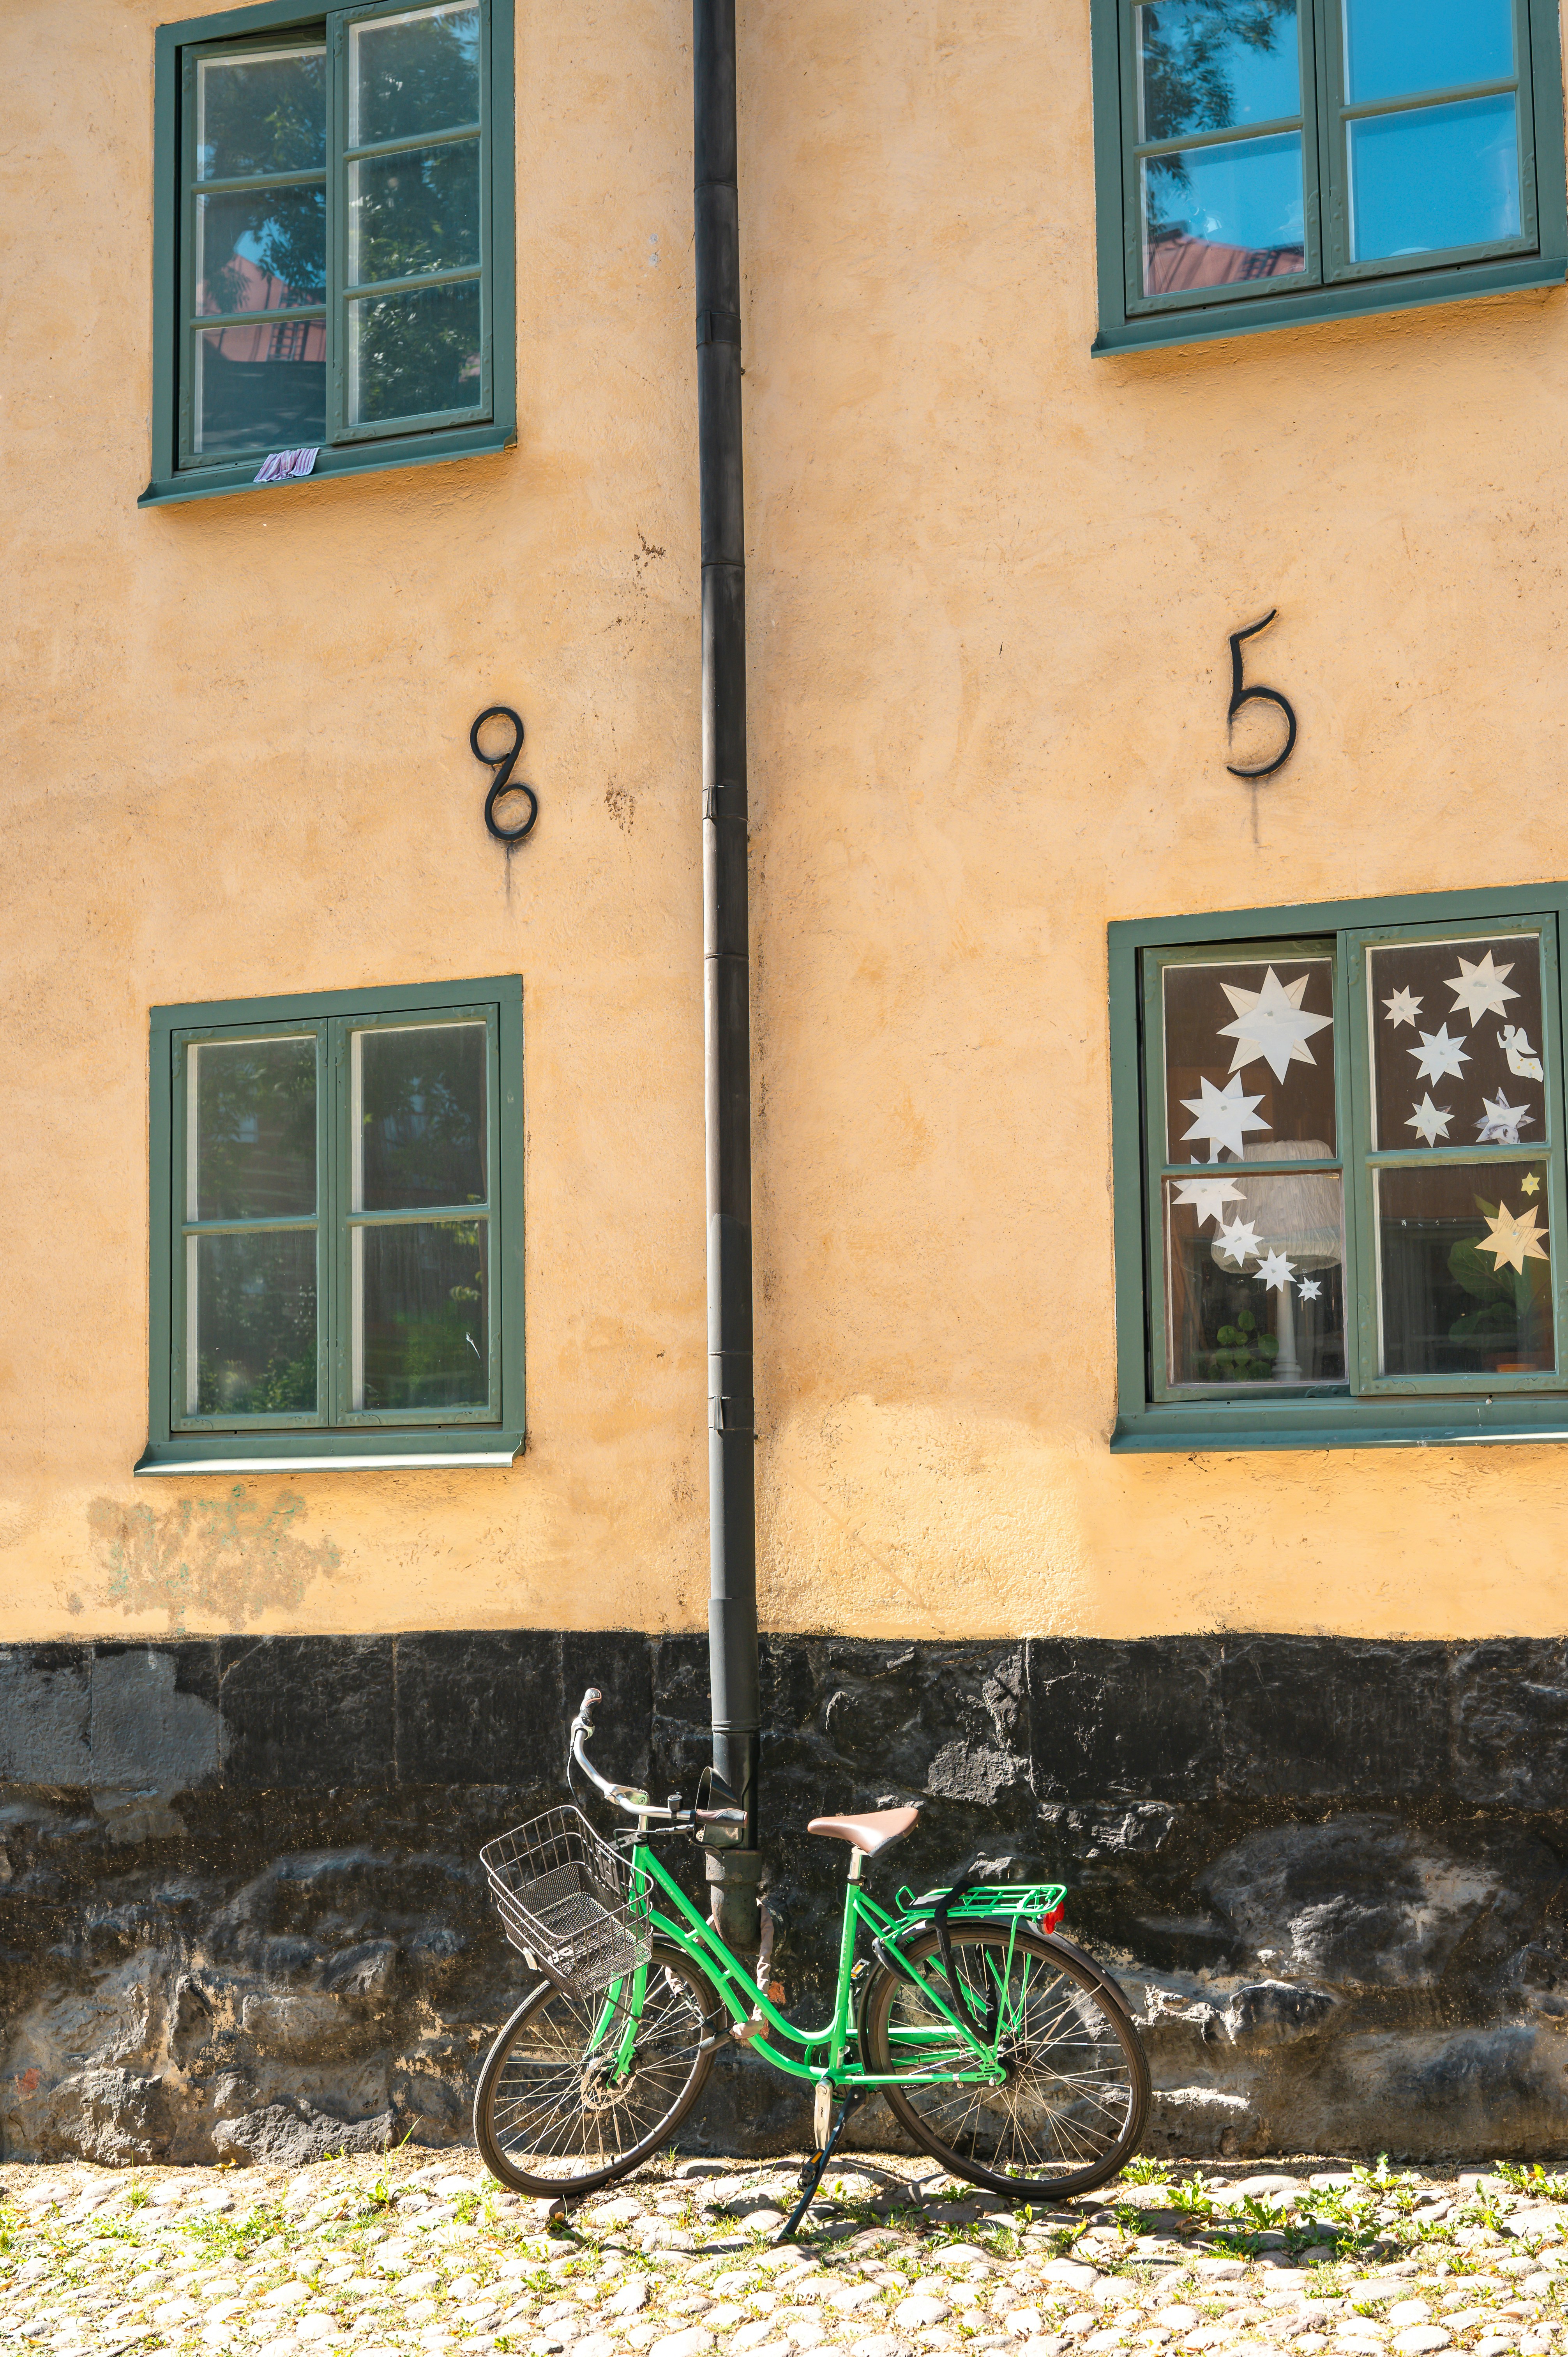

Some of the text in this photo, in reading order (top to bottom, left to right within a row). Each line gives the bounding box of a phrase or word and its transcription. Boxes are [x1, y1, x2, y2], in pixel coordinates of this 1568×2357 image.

[1227, 609, 1297, 779] 5
[470, 706, 538, 842] 8
[657, 1875, 673, 1895] NATUR
